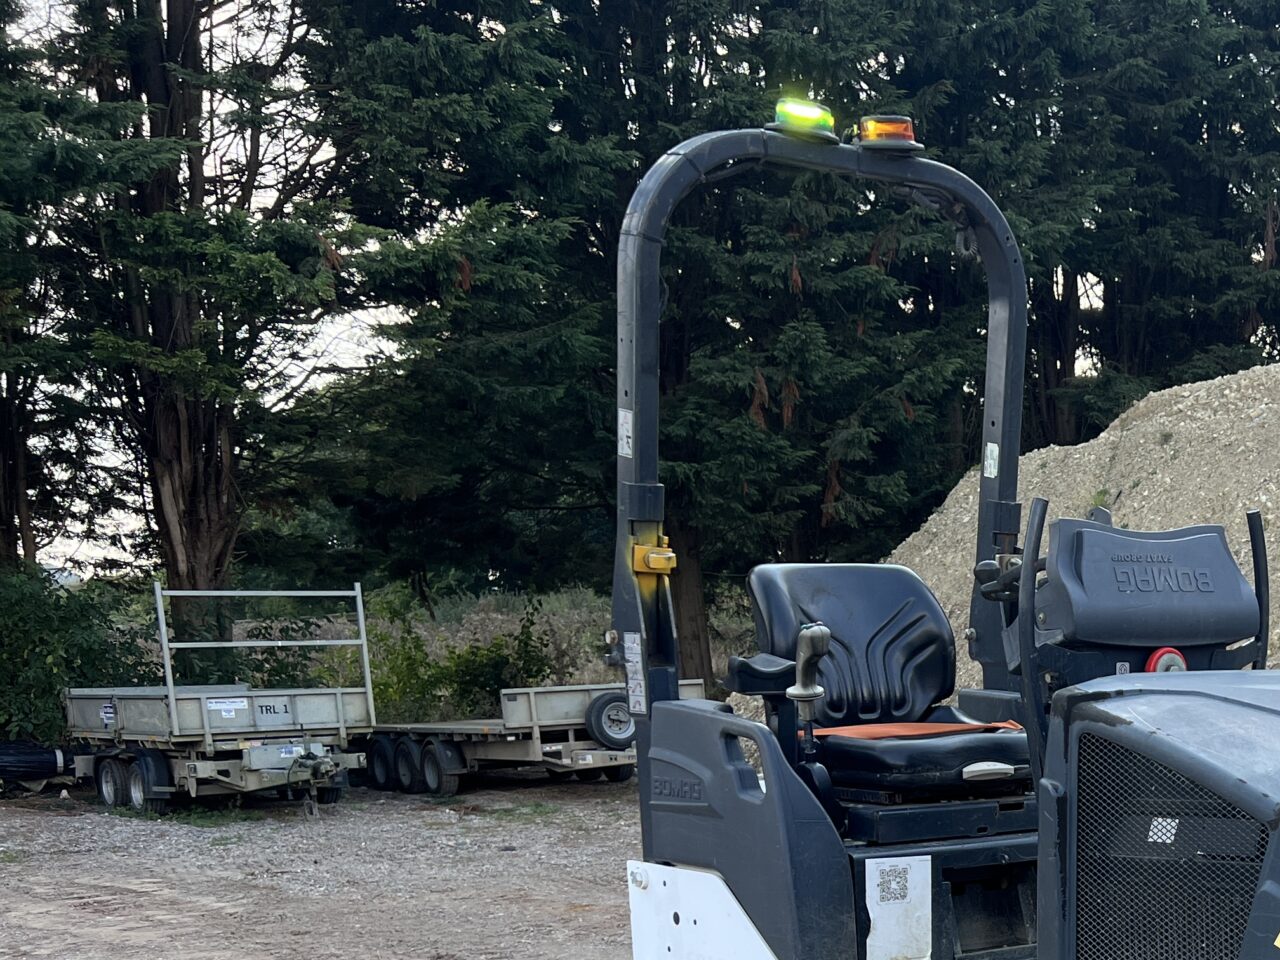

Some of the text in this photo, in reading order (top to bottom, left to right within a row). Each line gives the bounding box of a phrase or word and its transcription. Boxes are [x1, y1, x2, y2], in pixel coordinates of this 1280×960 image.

[1111, 553, 1145, 563] GROUP
[1113, 566, 1215, 593] BOMAG
[258, 704, 290, 715] TRL 1
